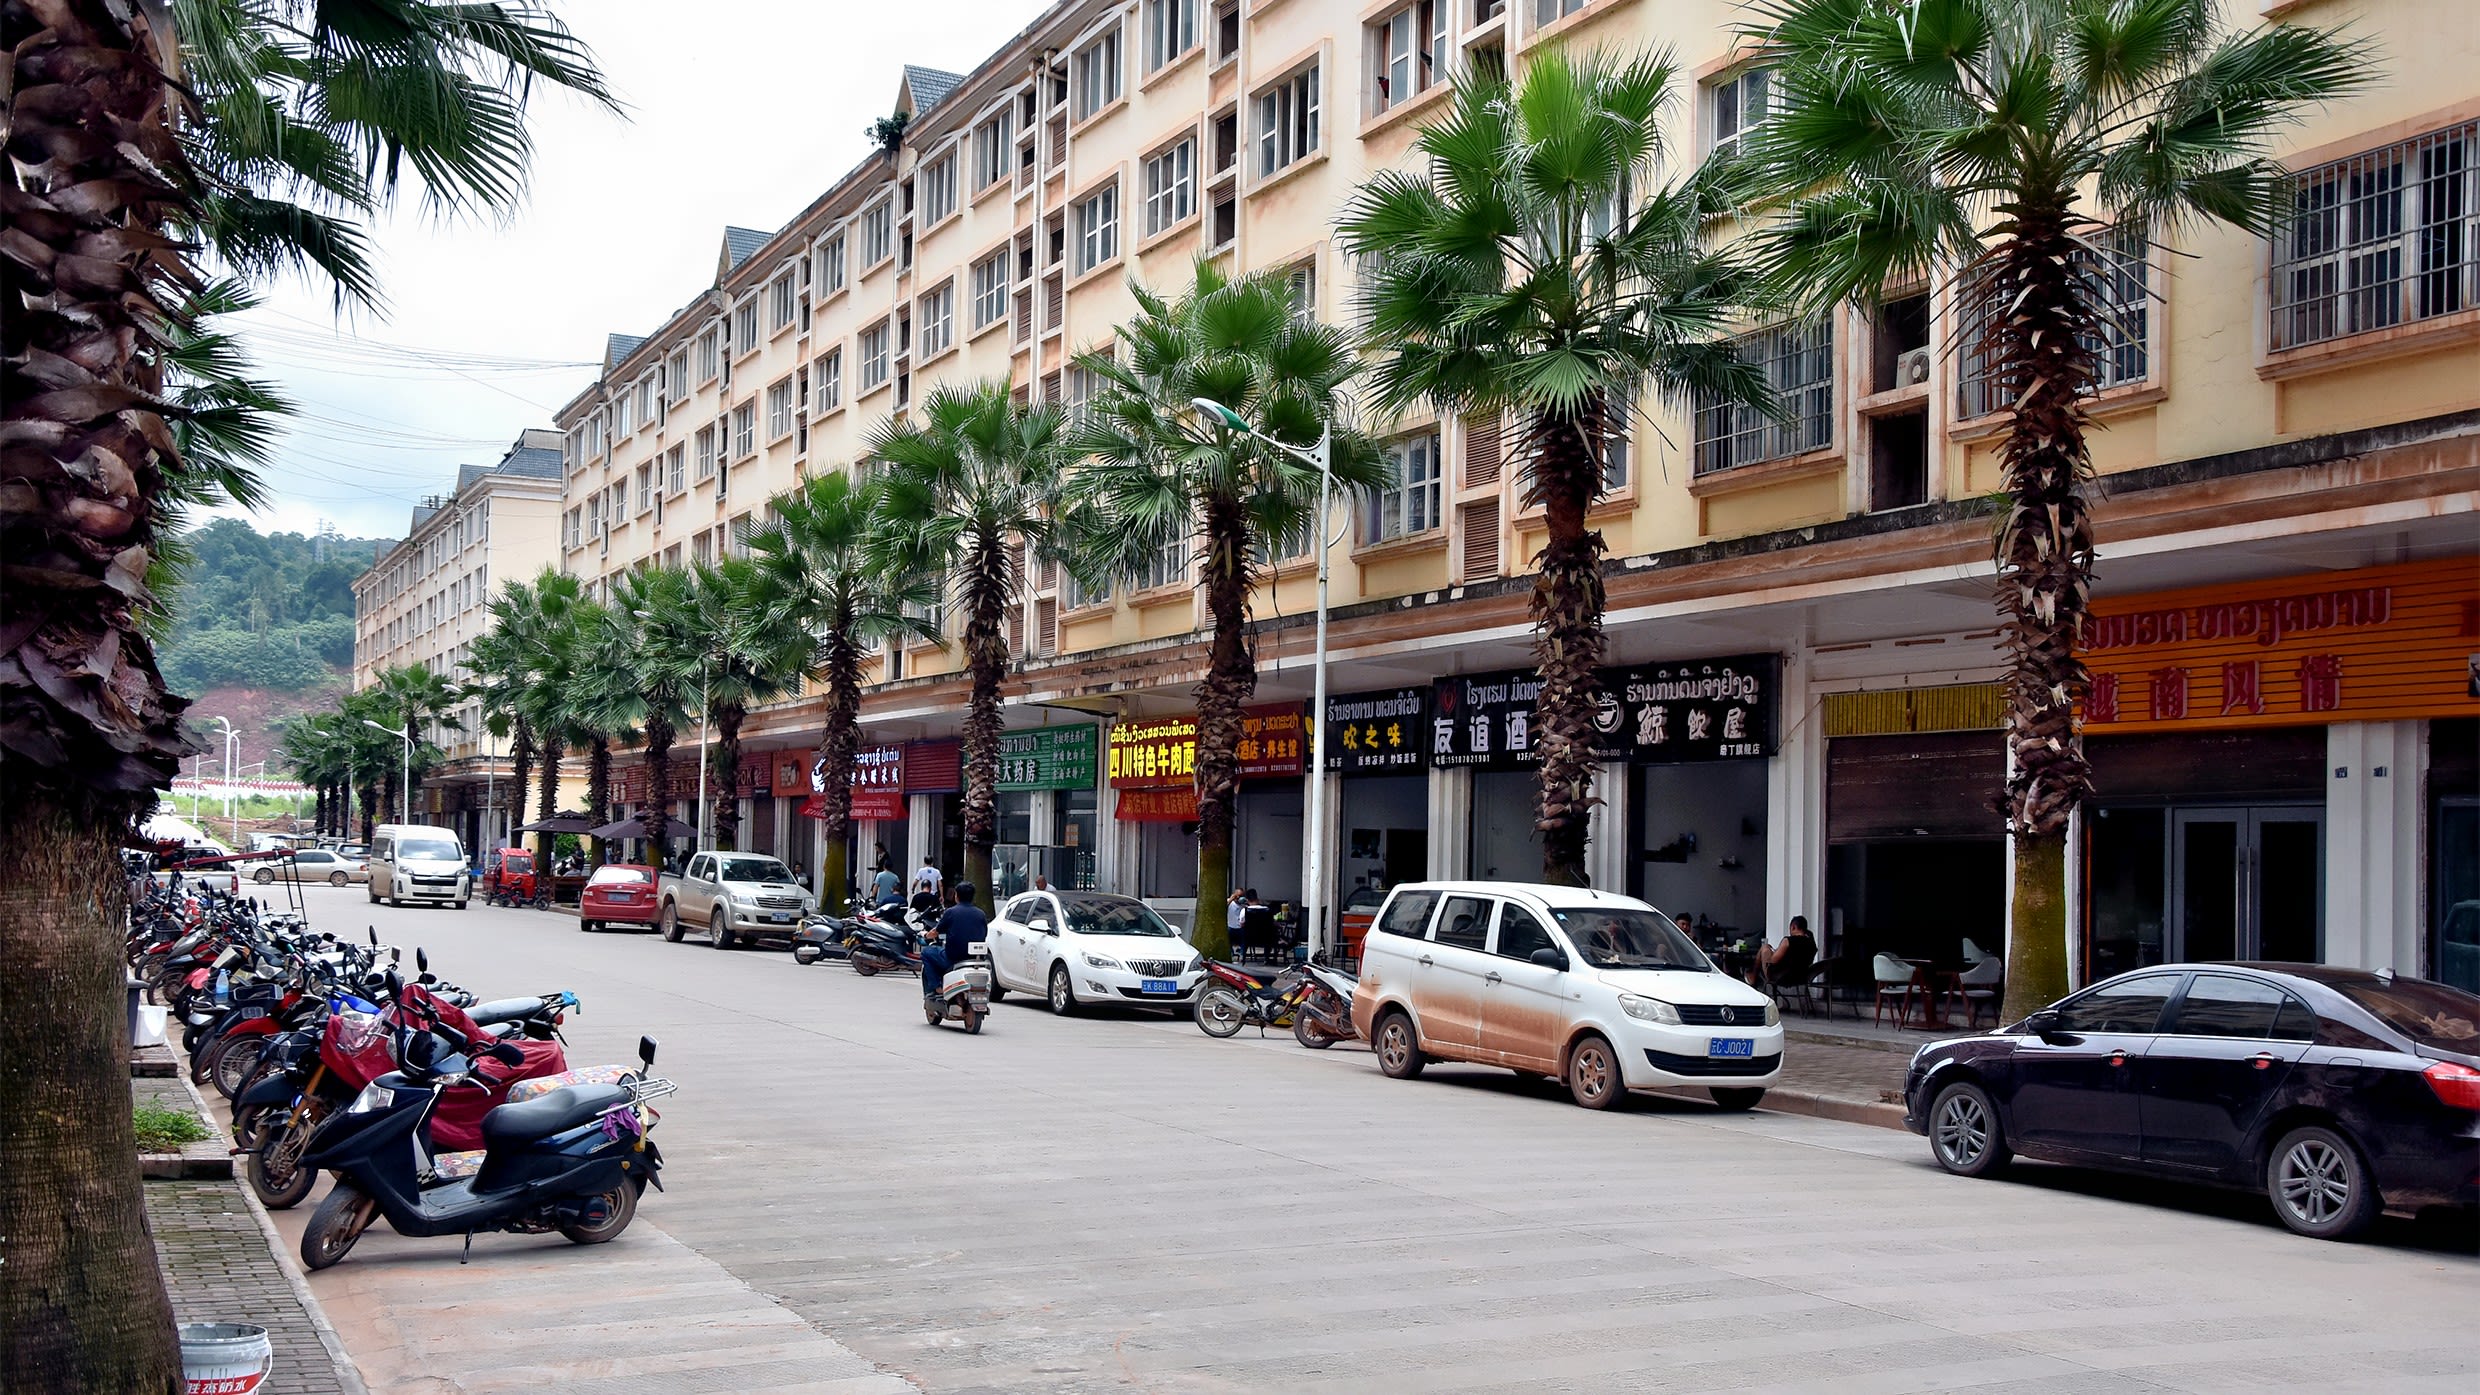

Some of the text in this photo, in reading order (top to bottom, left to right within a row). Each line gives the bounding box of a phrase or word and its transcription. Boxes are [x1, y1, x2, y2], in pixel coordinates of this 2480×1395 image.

[1433, 710, 1528, 754] 友谊酒
[1109, 741, 1196, 779] 四川特色牛肉面
